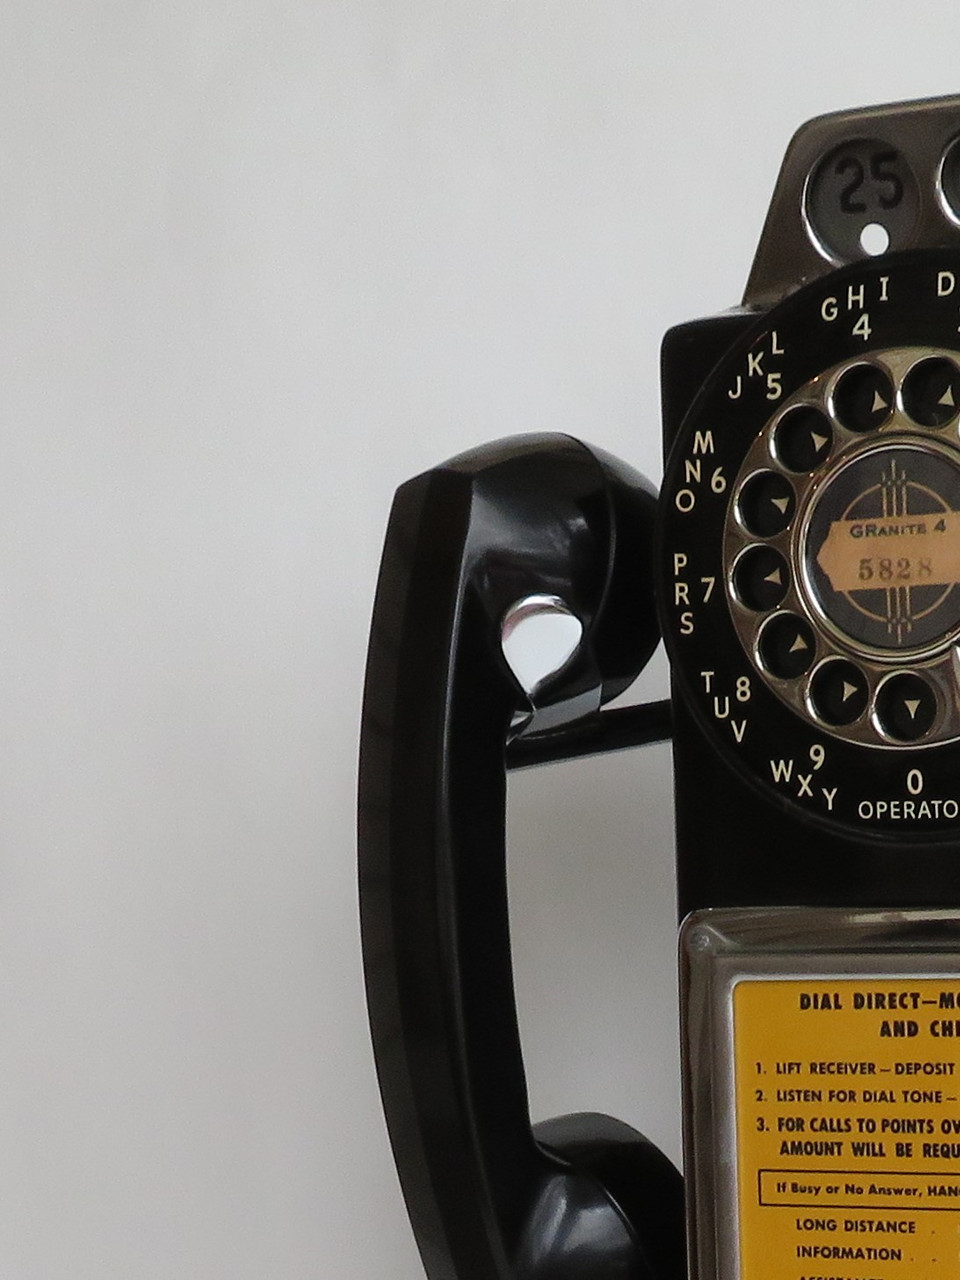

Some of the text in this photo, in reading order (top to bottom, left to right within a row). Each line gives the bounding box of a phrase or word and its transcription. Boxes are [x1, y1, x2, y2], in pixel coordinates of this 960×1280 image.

[835, 151, 903, 214] 25
[852, 313, 872, 341] 4
[766, 373, 782, 400] 5
[711, 467, 727, 493] 6
[849, 519, 947, 539] GRANITE 4
[858, 558, 933, 581] 5828
[701, 577, 715, 603] 7
[736, 676, 751, 702] 8
[809, 744, 825, 770] 9
[799, 992, 843, 1011] DIAL
[879, 1020, 919, 1038] AND
[755, 1062, 767, 1075] 1.
[776, 1061, 802, 1075] LIFT
[755, 1089, 768, 1102] 2.
[776, 1089, 823, 1103] LISTEN
[828, 1089, 857, 1103] FOR
[862, 1090, 897, 1104] DIAL
[901, 1089, 943, 1104] TONE
[756, 1116, 770, 1133] 3.
[777, 1116, 805, 1133] FOR
[809, 1117, 852, 1133] CALLS
[856, 1117, 877, 1134] TO
[881, 1118, 935, 1135] POINTS
[779, 1140, 844, 1157] AMOUNT
[850, 1141, 887, 1158] WILL
[895, 1142, 913, 1158] BE
[776, 1181, 787, 1193] If
[790, 1182, 822, 1197] Busy
[825, 1185, 840, 1194] or
[844, 1183, 864, 1195] No
[868, 1183, 923, 1198] Answer,
[796, 1218, 916, 1234] LONG DISTANCE
[796, 1245, 902, 1261] INFORMATION
